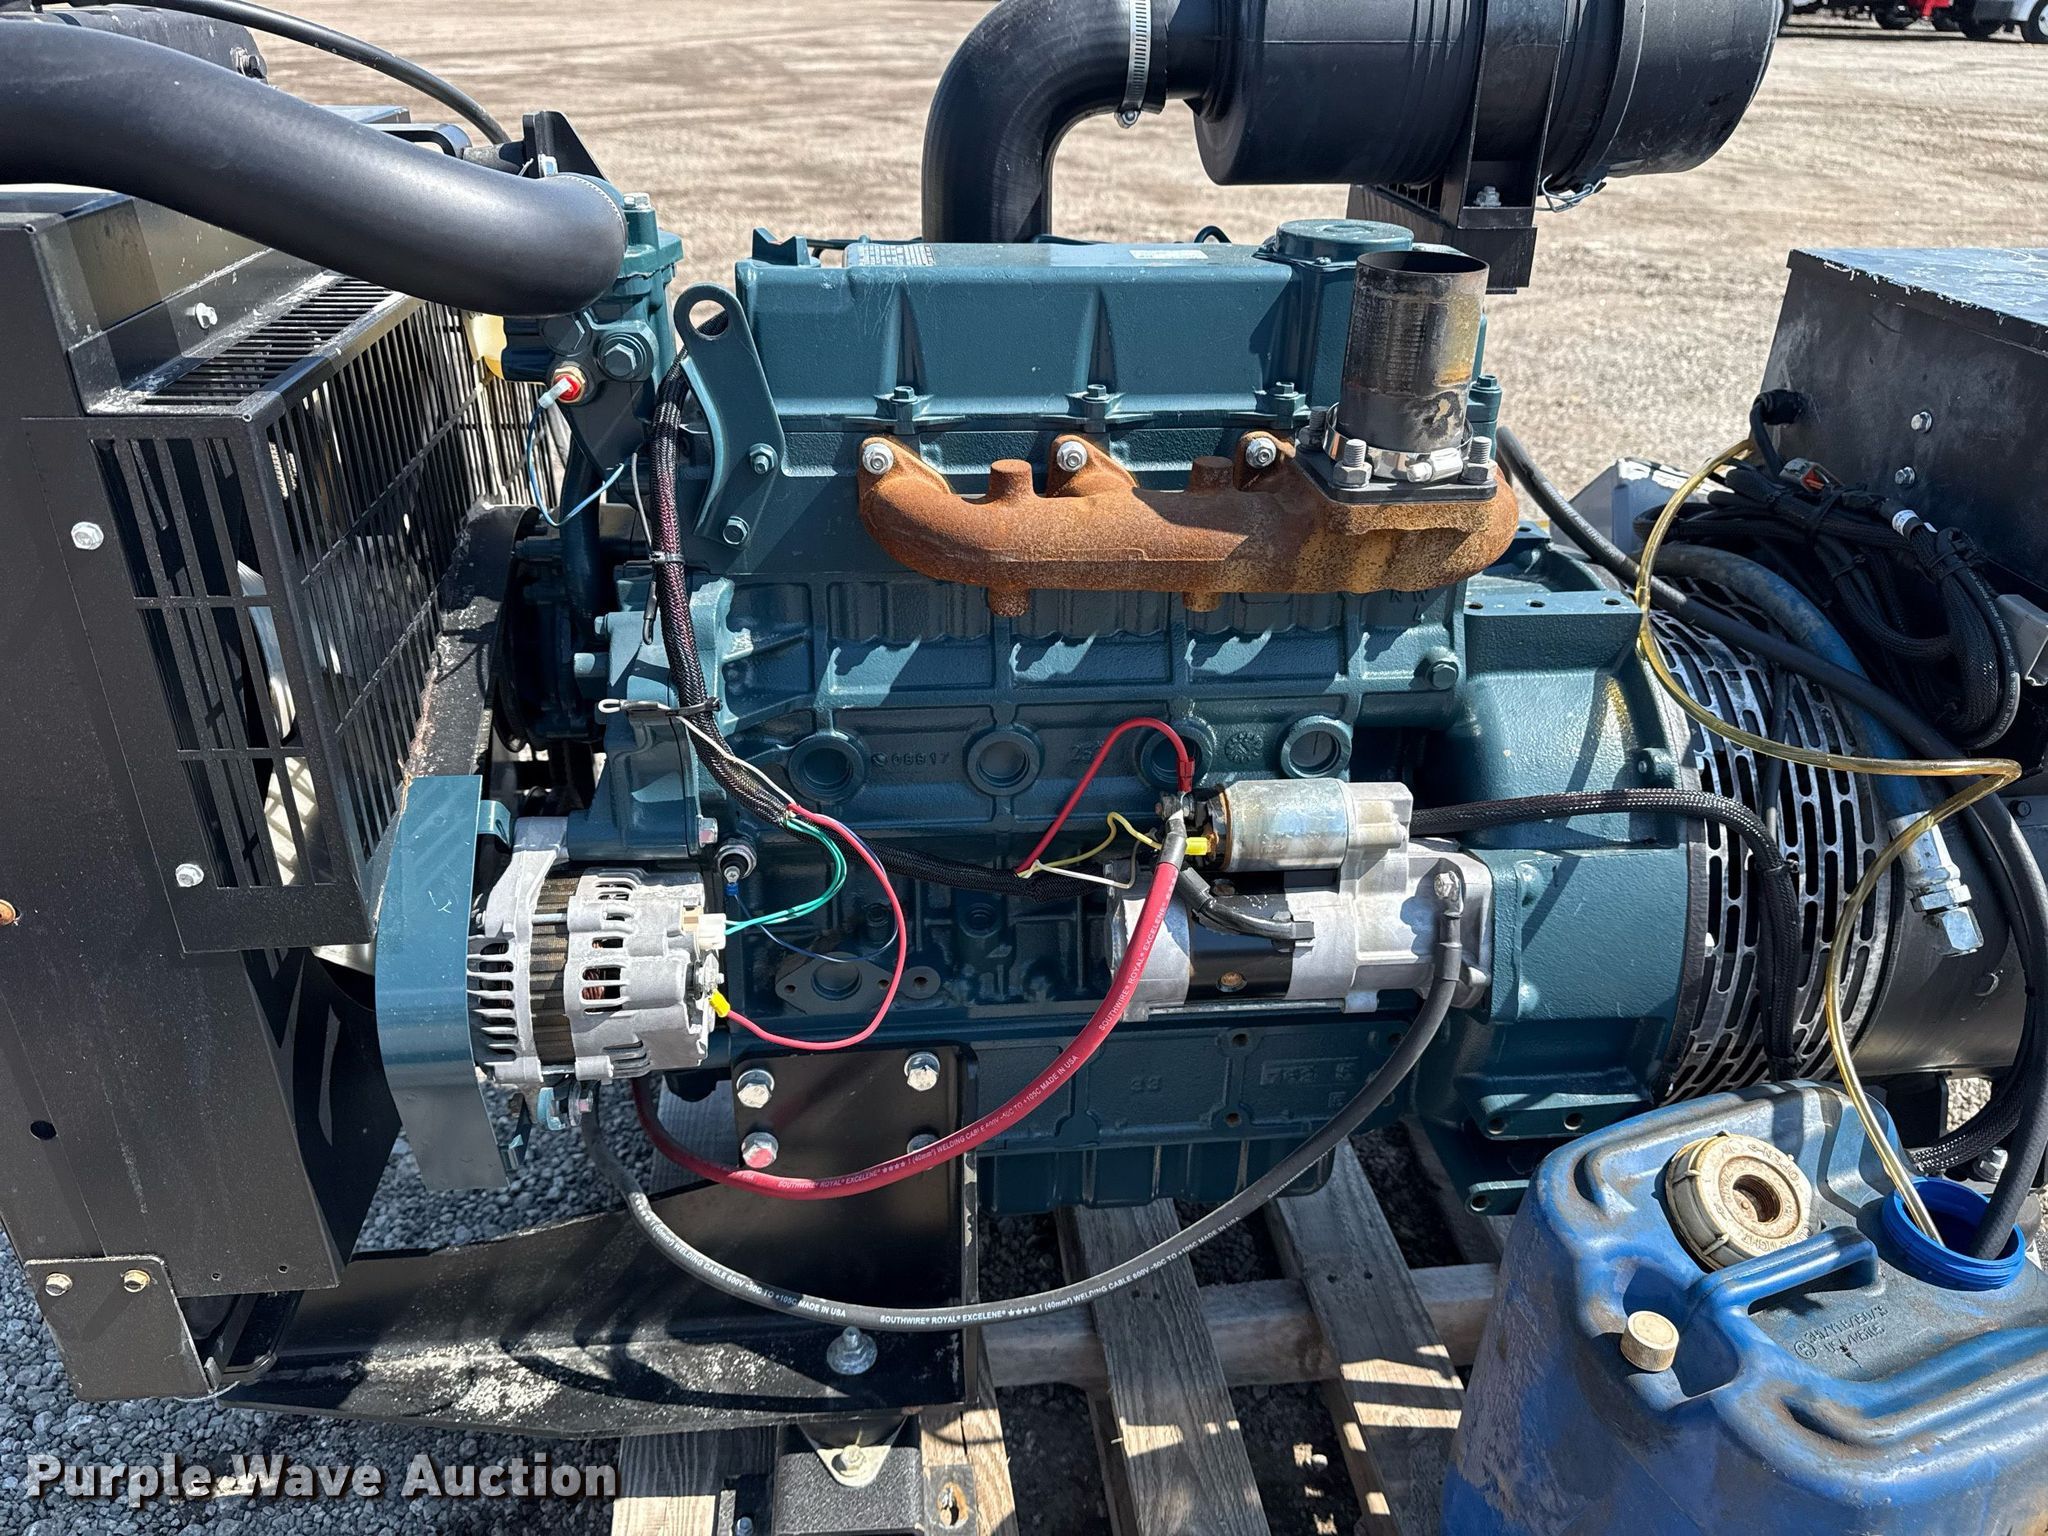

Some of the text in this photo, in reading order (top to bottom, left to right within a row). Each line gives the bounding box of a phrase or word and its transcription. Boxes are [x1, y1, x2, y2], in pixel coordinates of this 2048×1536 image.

[936, 1134, 966, 1156] WELDING
[1040, 1073, 1059, 1091] MADE
[1057, 1066, 1067, 1076] IN
[1064, 1054, 1079, 1069] USA
[674, 1241, 703, 1266] WELDING
[703, 1261, 726, 1280] CABLE
[727, 1274, 745, 1288] 600V
[798, 1300, 820, 1312] MADE
[821, 1306, 829, 1314] IN
[830, 1307, 846, 1318] USA
[1072, 1285, 1108, 1302] WELDING
[1108, 1275, 1133, 1292] CABLE
[1133, 1268, 1150, 1280] 600V
[1166, 1252, 1178, 1263] TO
[1198, 1229, 1219, 1244] MADE
[1217, 1223, 1226, 1233] IN
[1225, 1216, 1243, 1228] USA
